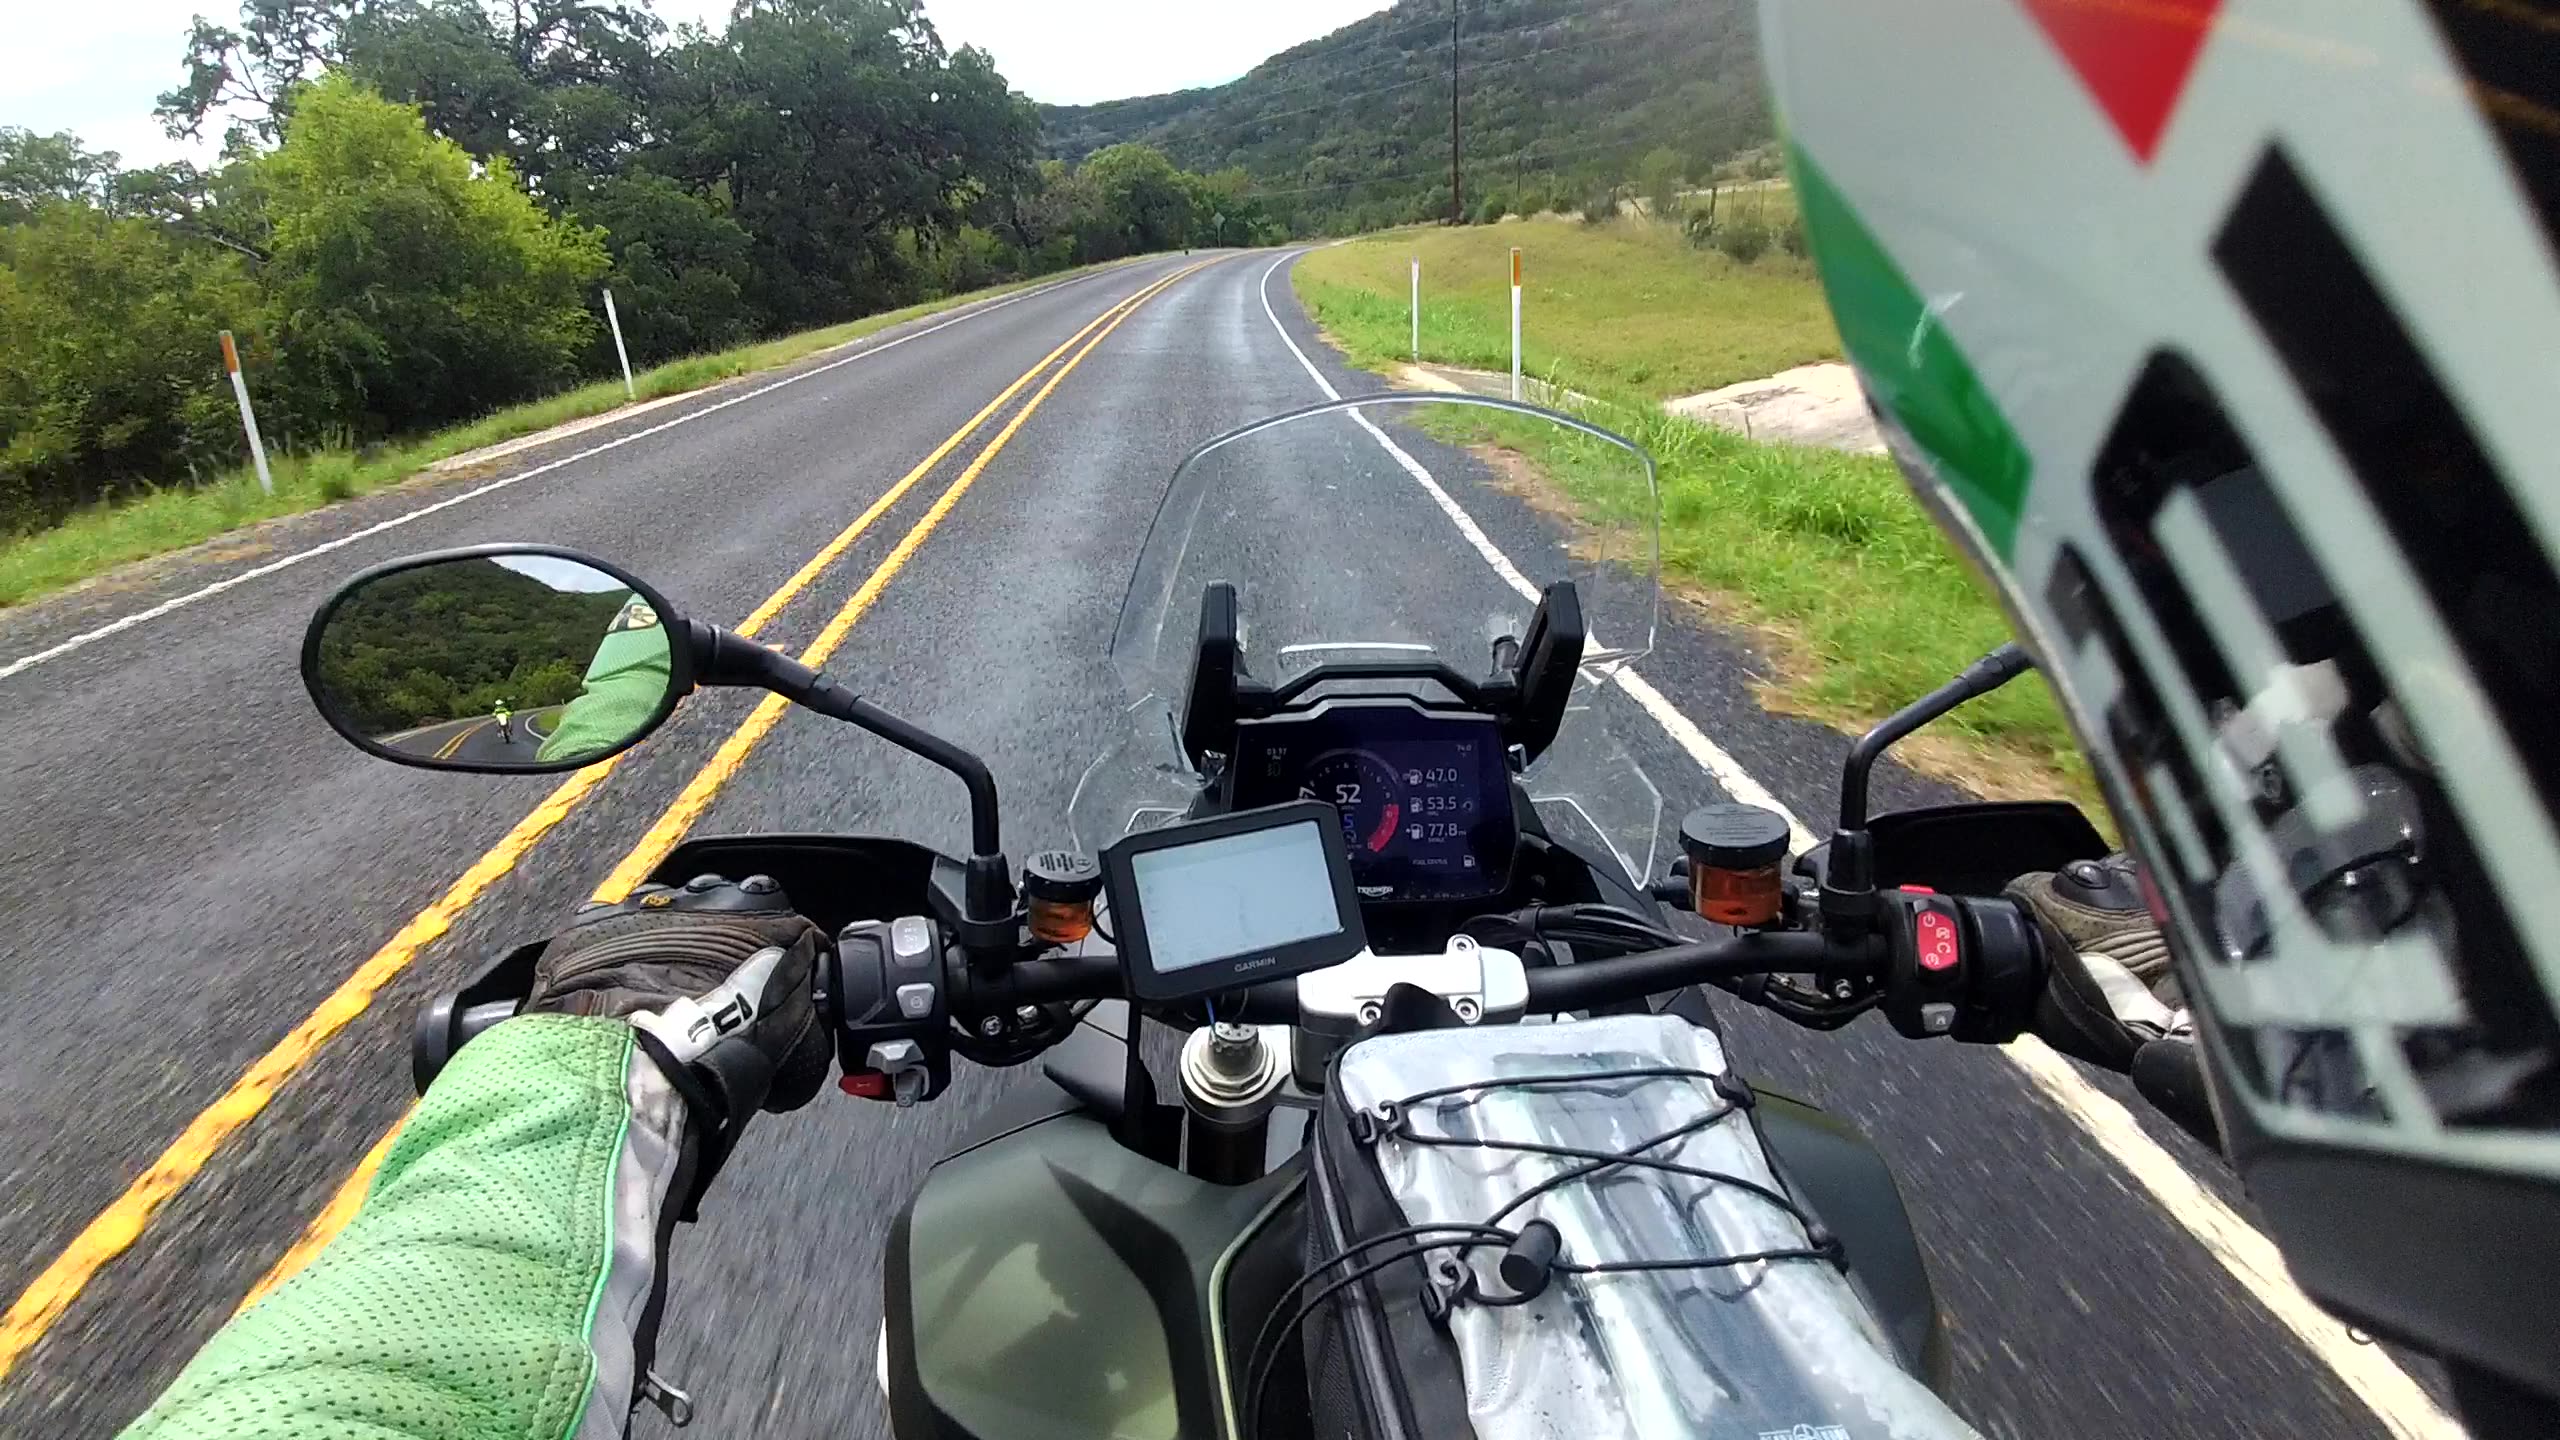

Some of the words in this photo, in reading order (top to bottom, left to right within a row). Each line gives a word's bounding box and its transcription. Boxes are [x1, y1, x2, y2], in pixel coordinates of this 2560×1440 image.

[1425, 768, 1458, 782] 47.0
[1336, 783, 1362, 804] 52
[1427, 796, 1457, 810] 53.5
[1428, 823, 1458, 837] 77.8
[1234, 956, 1276, 973] GARMIN
